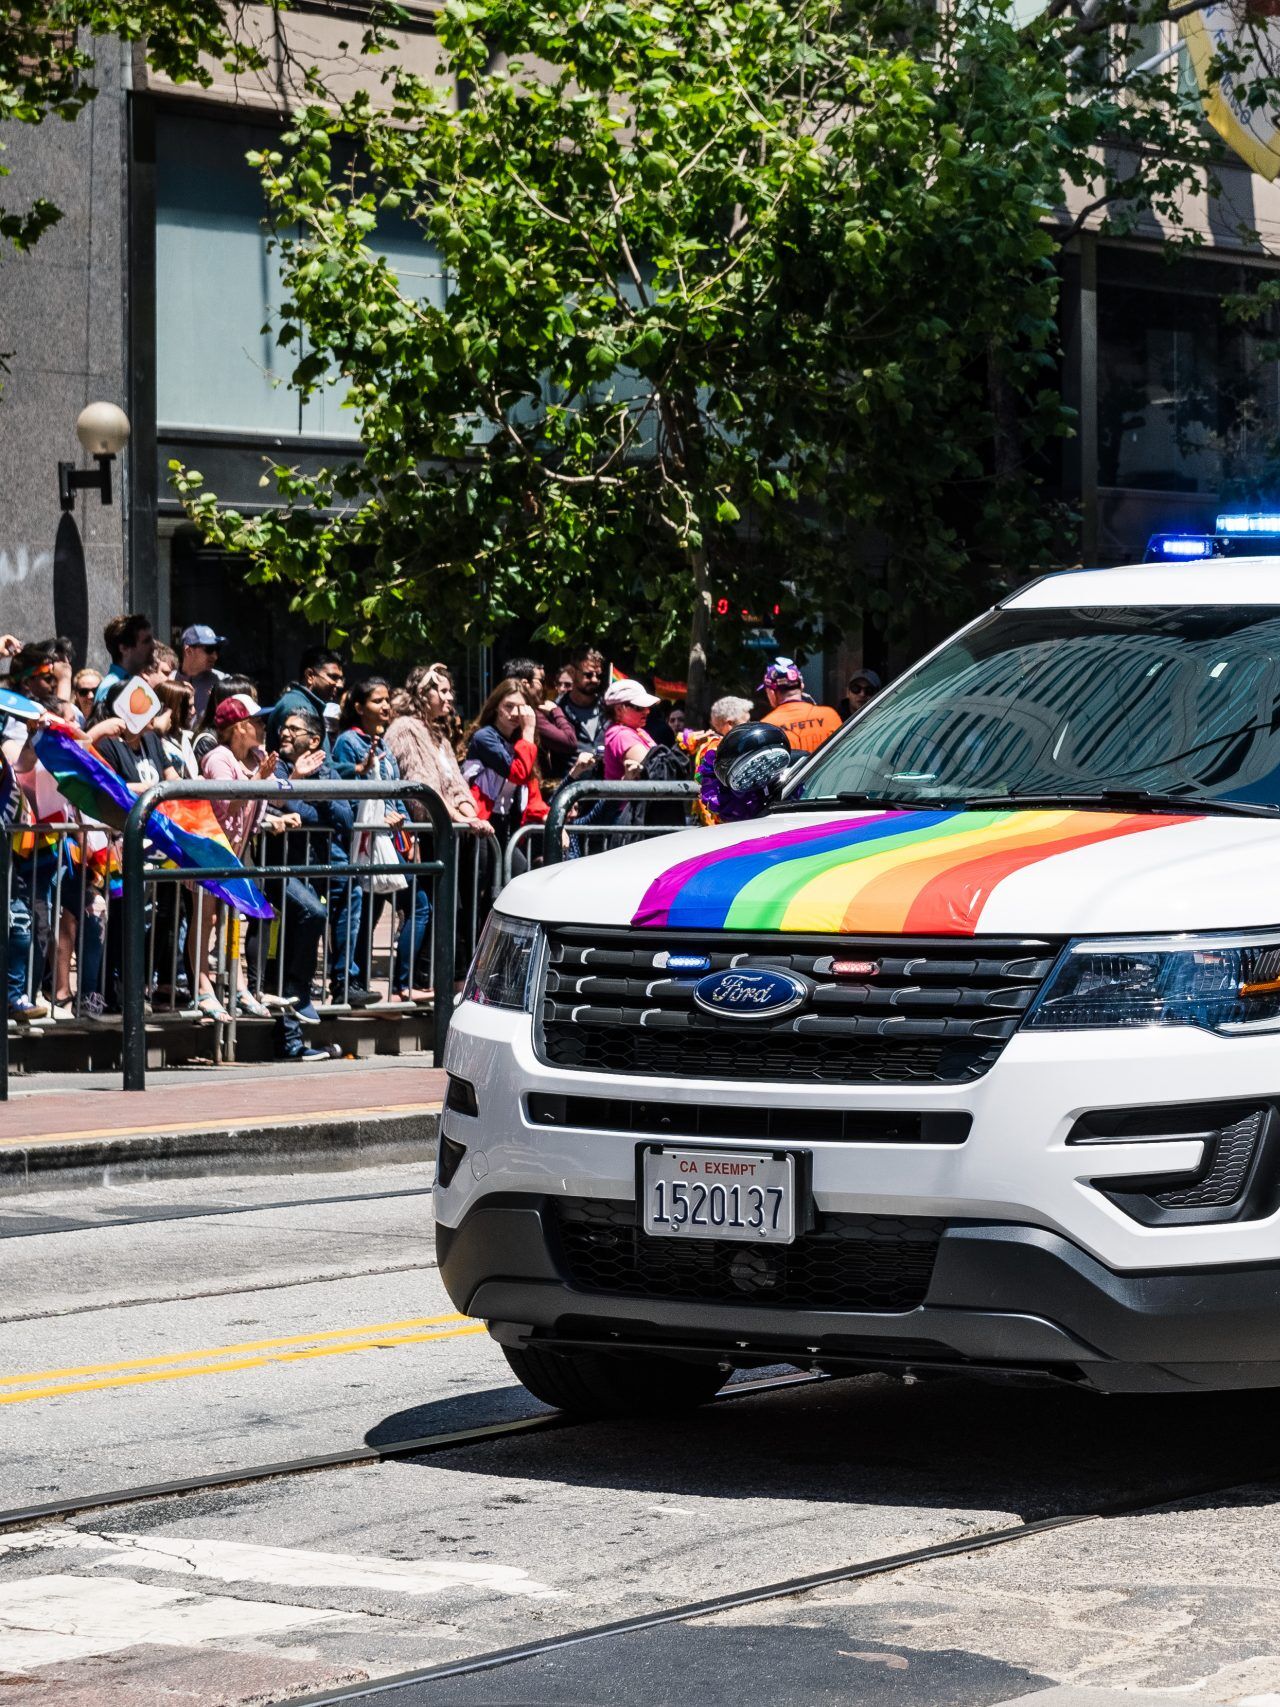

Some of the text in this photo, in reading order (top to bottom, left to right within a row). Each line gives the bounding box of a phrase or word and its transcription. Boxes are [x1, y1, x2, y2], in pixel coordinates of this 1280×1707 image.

[780, 718, 825, 731] AFETY
[712, 974, 776, 1003] Ford
[679, 1160, 757, 1176] CA EXEMPT
[653, 1179, 785, 1230] 1520137
